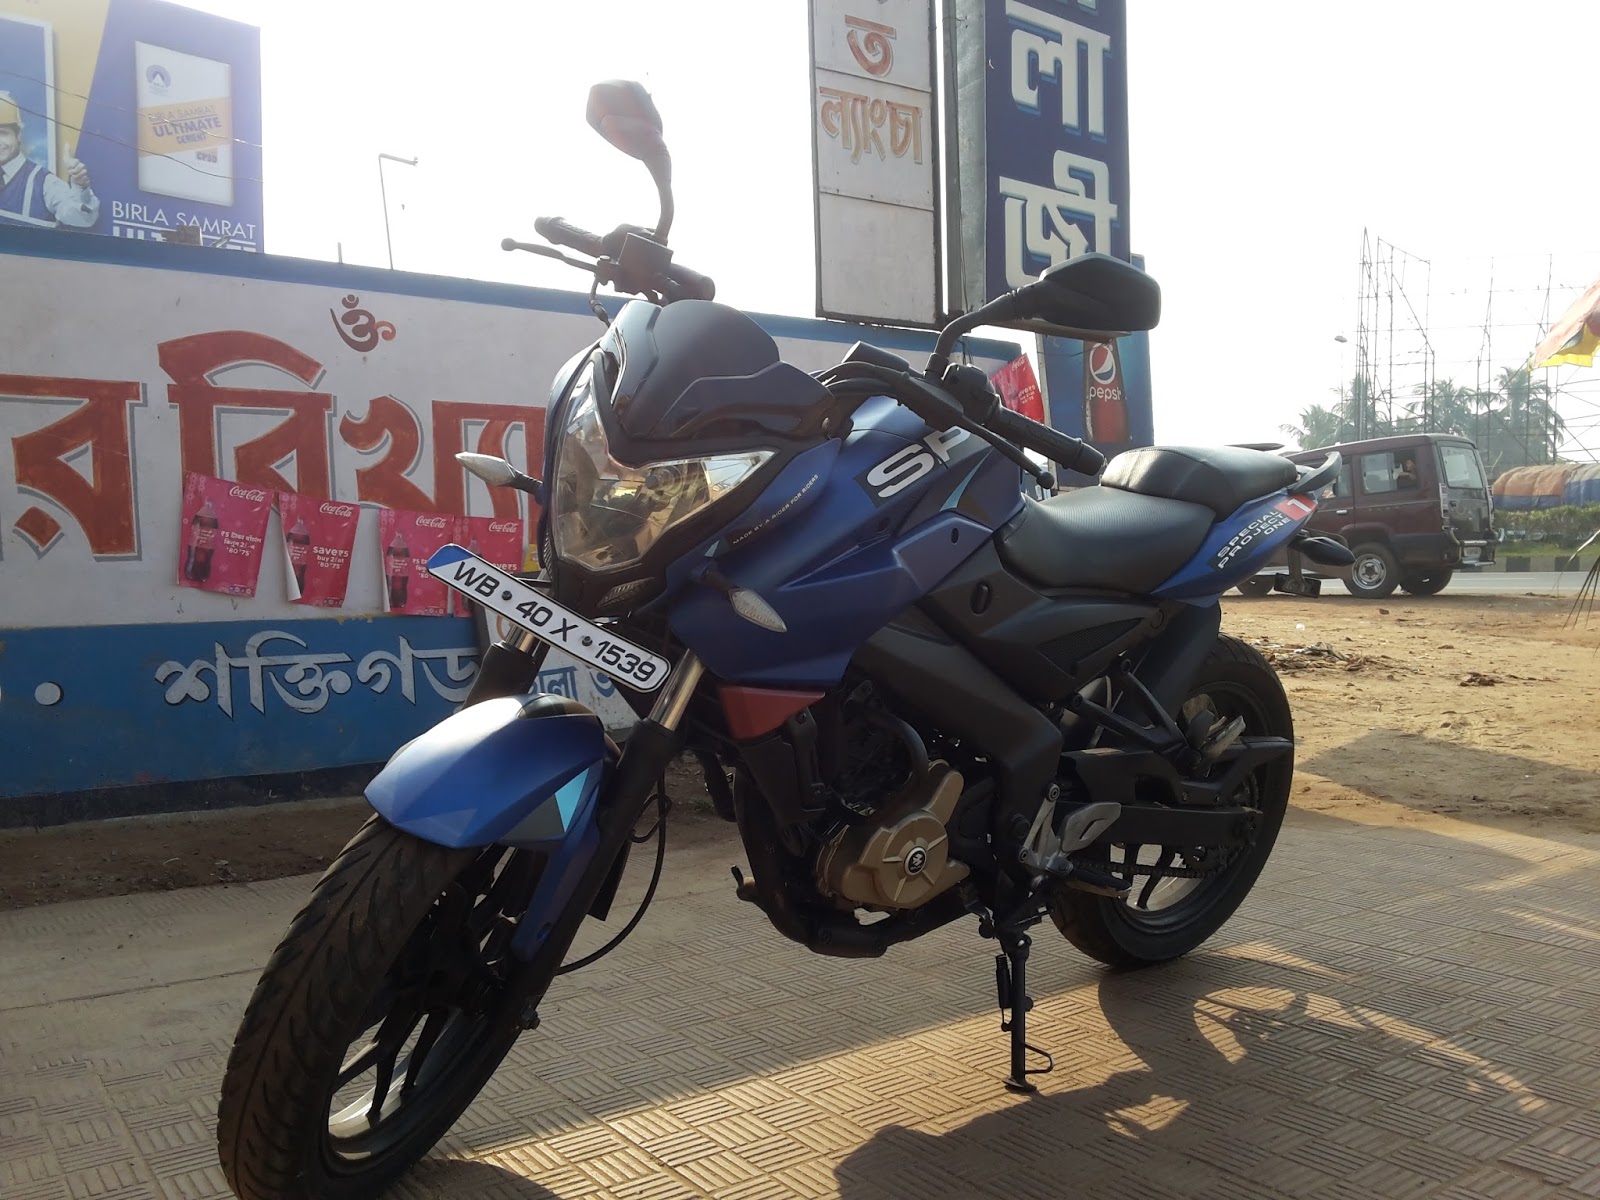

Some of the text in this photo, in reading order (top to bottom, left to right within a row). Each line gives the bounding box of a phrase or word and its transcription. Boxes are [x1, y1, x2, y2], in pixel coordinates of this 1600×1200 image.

[845, 14, 896, 77] ত
[153, 117, 222, 137] ULTIMATE
[819, 86, 922, 165] ল্যাংচা
[112, 200, 169, 226] BIRLA
[176, 212, 256, 240] SAMRAT
[1089, 386, 1121, 402] pepsi
[733, 530, 753, 545] MADE
[754, 523, 763, 531] BY
[771, 503, 790, 519] RIDER
[790, 492, 802, 504] FOR
[801, 474, 818, 493] RIDERS
[1264, 516, 1291, 535] ONE
[1287, 498, 1311, 513] 1
[1217, 511, 1279, 558] SPECIAL
[1217, 513, 1283, 569] PROJECT
[453, 560, 656, 682] WB 40 X 1539
